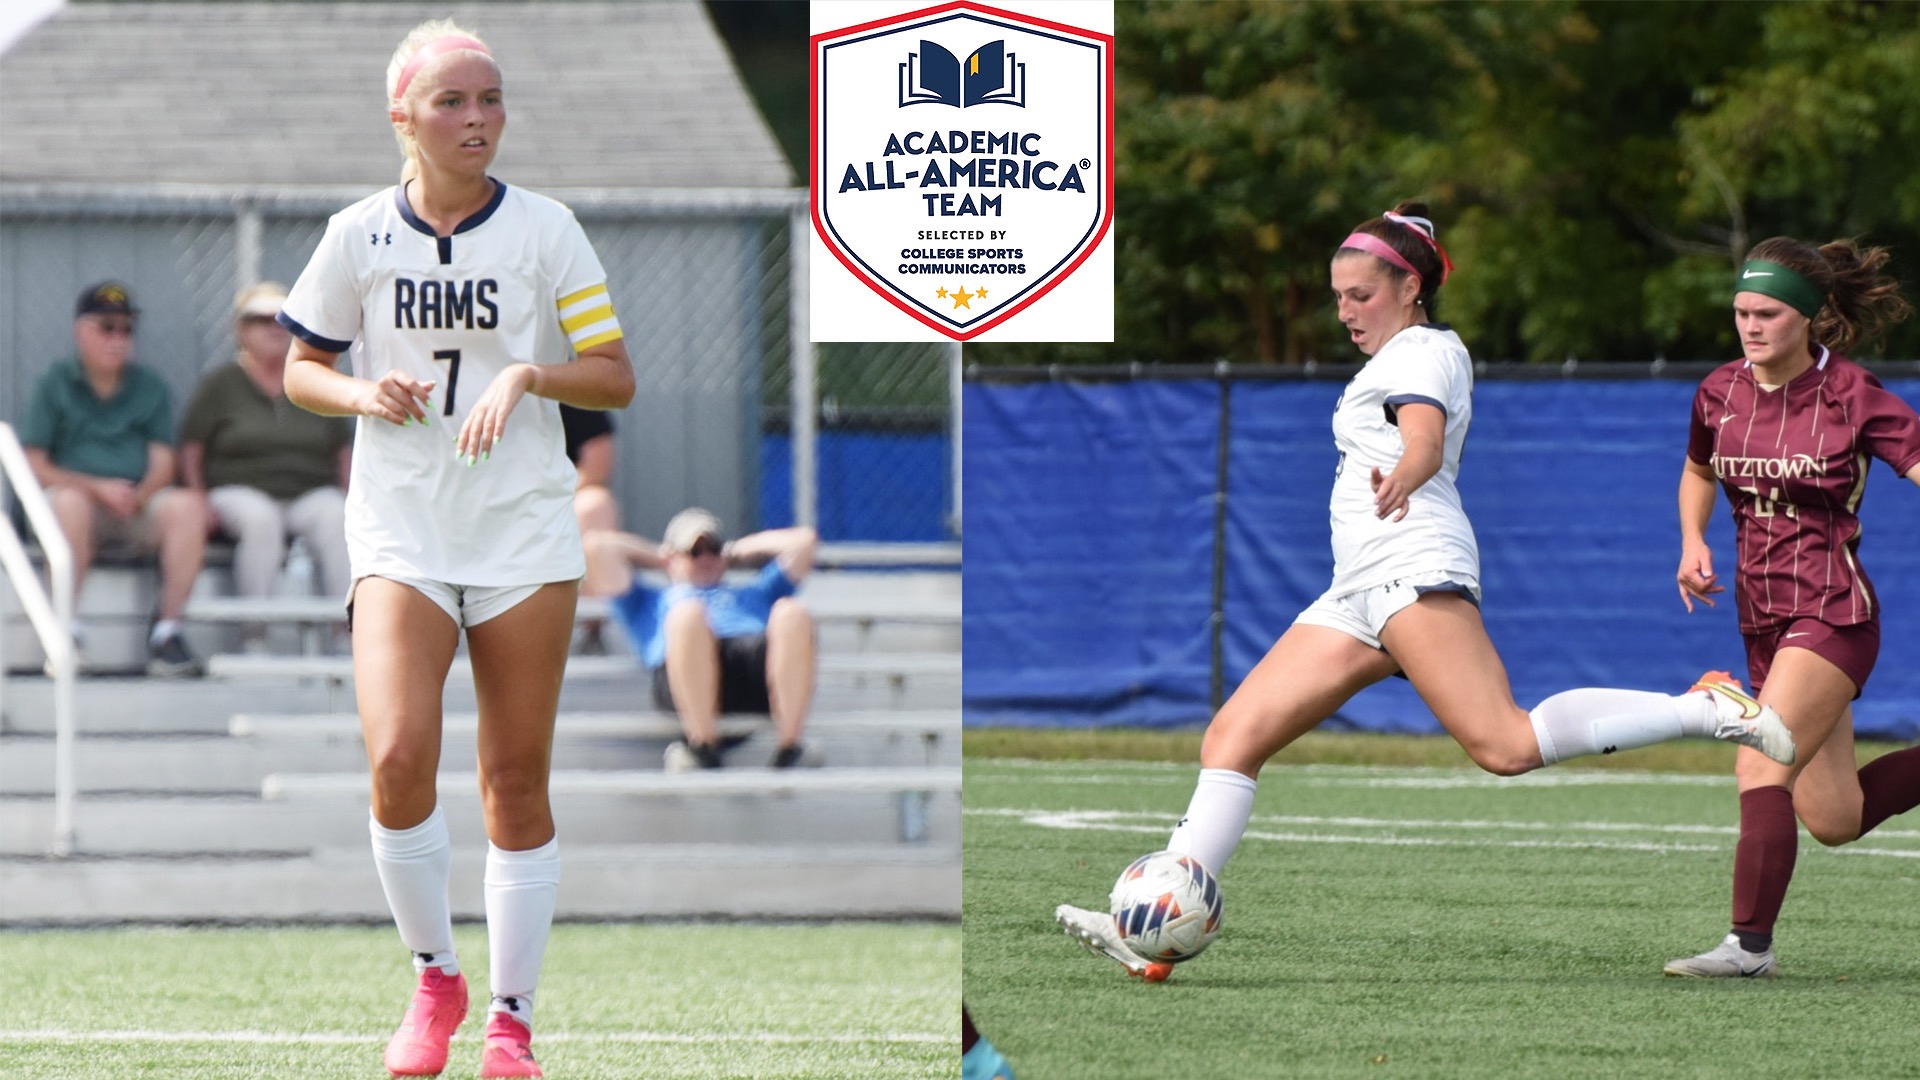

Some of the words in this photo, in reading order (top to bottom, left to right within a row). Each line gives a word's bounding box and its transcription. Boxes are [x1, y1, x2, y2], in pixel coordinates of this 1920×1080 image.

[394, 278, 499, 330] RAMS
[433, 349, 461, 416] 7
[1710, 453, 1828, 479] UTZTOWN
